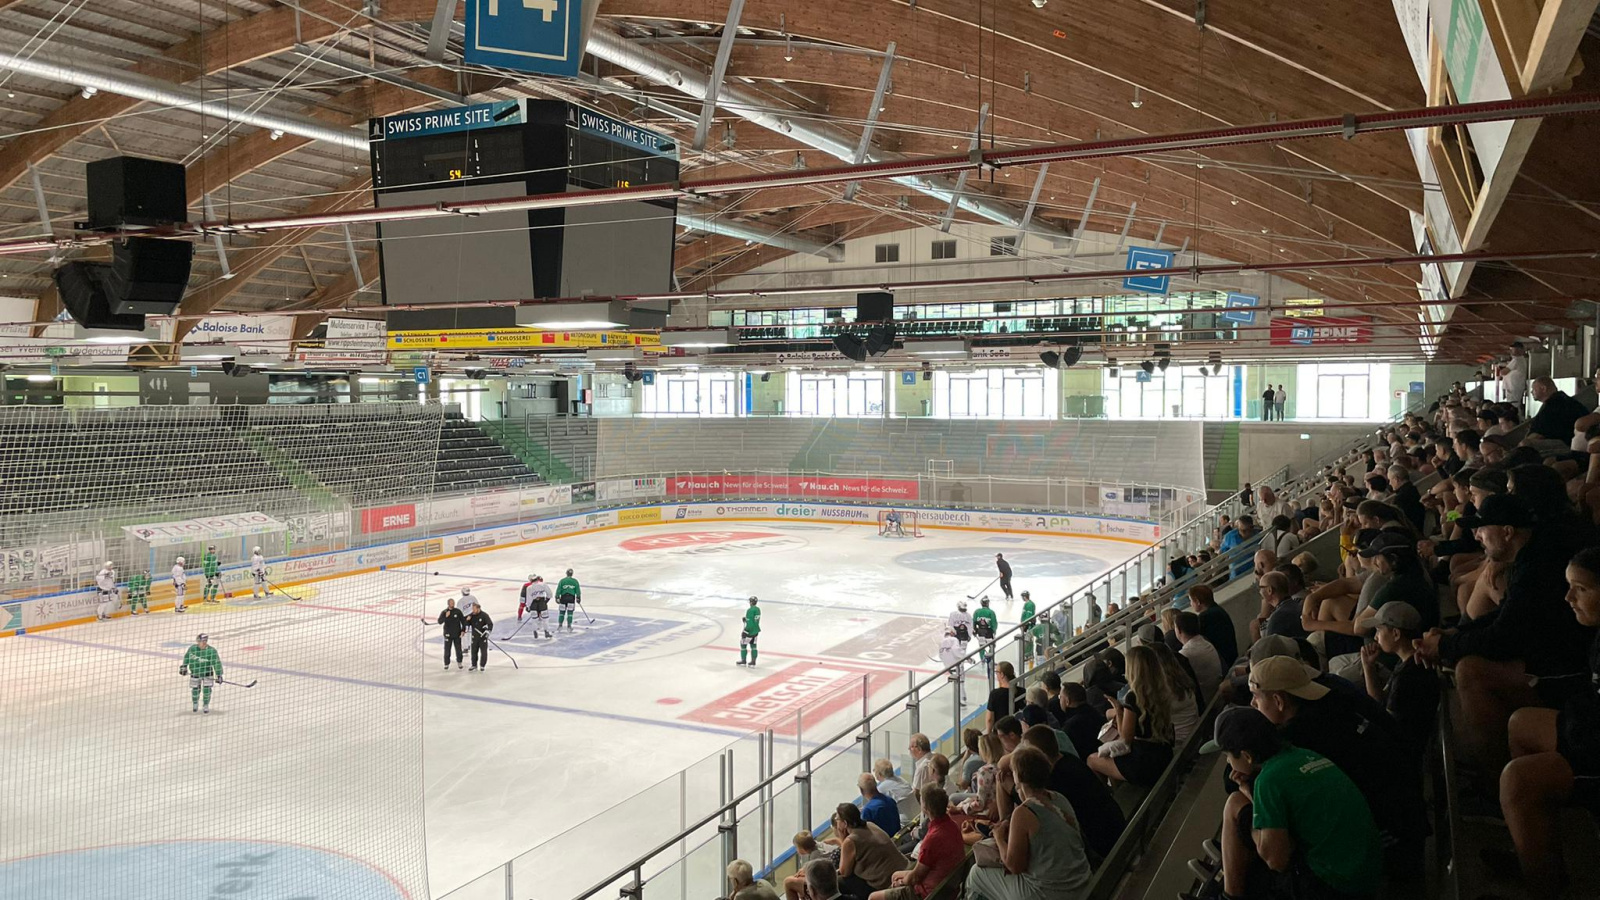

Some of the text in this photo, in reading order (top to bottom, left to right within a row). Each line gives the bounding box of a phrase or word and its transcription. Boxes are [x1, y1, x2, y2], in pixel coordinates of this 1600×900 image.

[388, 108, 490, 134] SWISS PRIME SITE
[581, 113, 657, 149] SWISS PRIME SITE
[202, 322, 238, 333] Baloise
[240, 324, 265, 334] Bank
[809, 482, 840, 491] Nau.ch
[776, 503, 817, 517] dreier
[821, 509, 862, 519] NUSSBAUM
[382, 513, 411, 527] ERNE
[1106, 523, 1125, 533] fischer
[56, 596, 103, 610] TRAUMWE
[721, 674, 833, 723] dietschi
